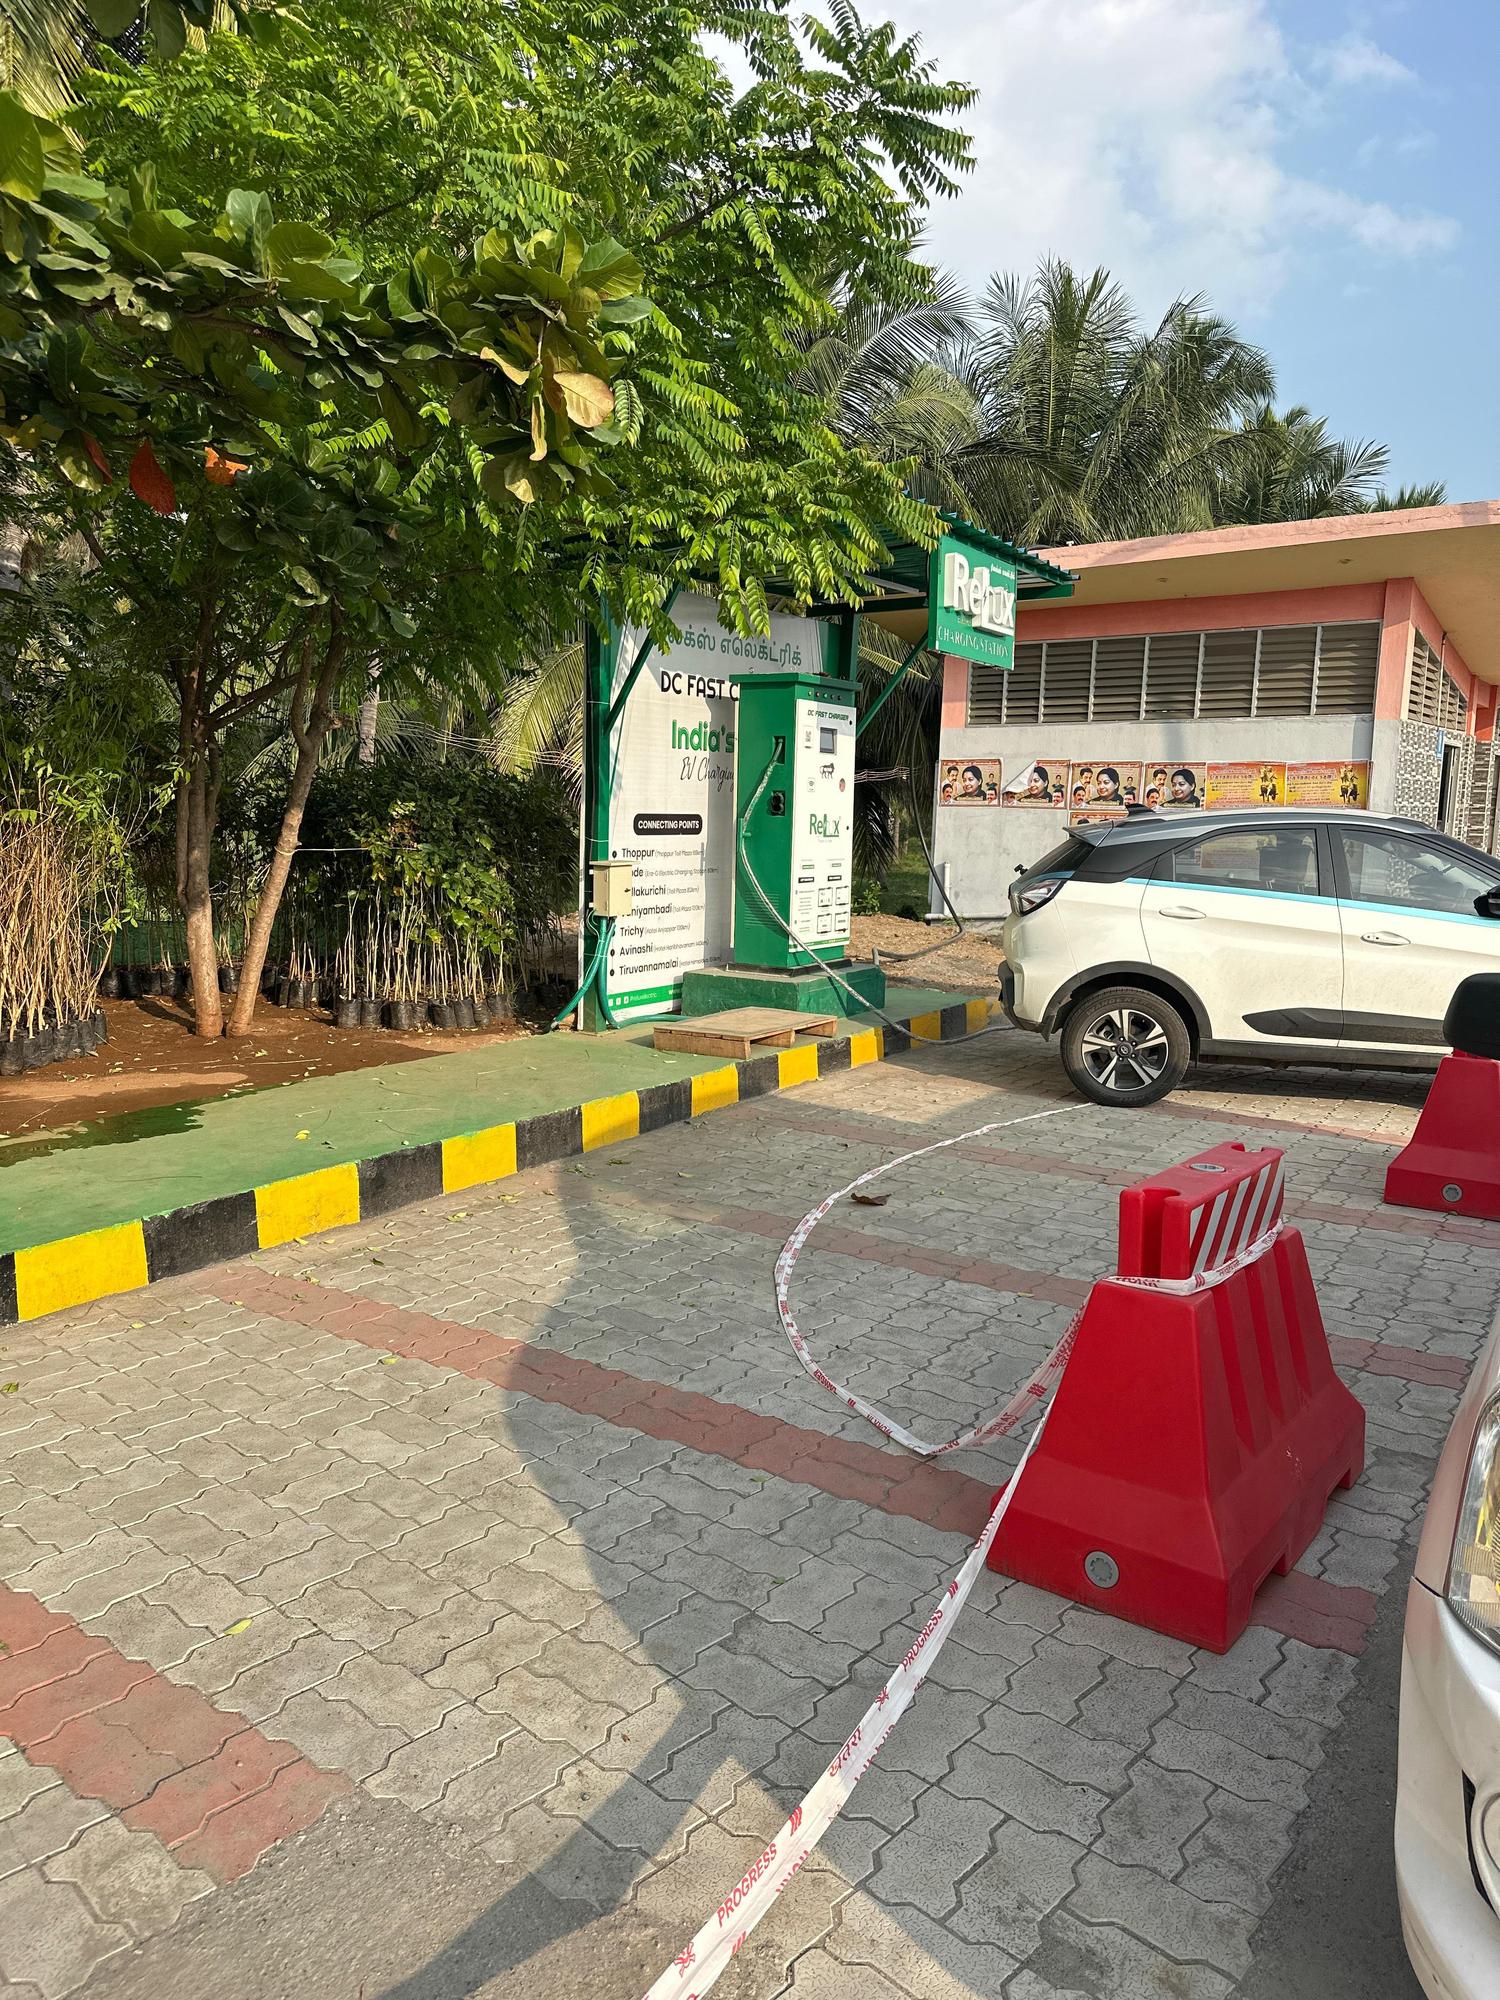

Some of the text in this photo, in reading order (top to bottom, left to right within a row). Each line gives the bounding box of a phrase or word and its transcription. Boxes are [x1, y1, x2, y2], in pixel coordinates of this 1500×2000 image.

[661, 670, 682, 694] DC
[687, 675, 725, 700] FAST
[672, 719, 735, 753] India's
[637, 820, 700, 830] CONNECTING POINTS
[622, 848, 655, 861] Thoppur
[631, 884, 667, 897] llakurichi
[622, 903, 672, 919] niyambadi
[620, 926, 645, 938] Trichy
[619, 942, 654, 956] Avinashi
[619, 957, 679, 976] Tiruvannamalai
[901, 1608, 944, 1672] PROGRESS
[716, 1842, 778, 1928] PROGRESS
